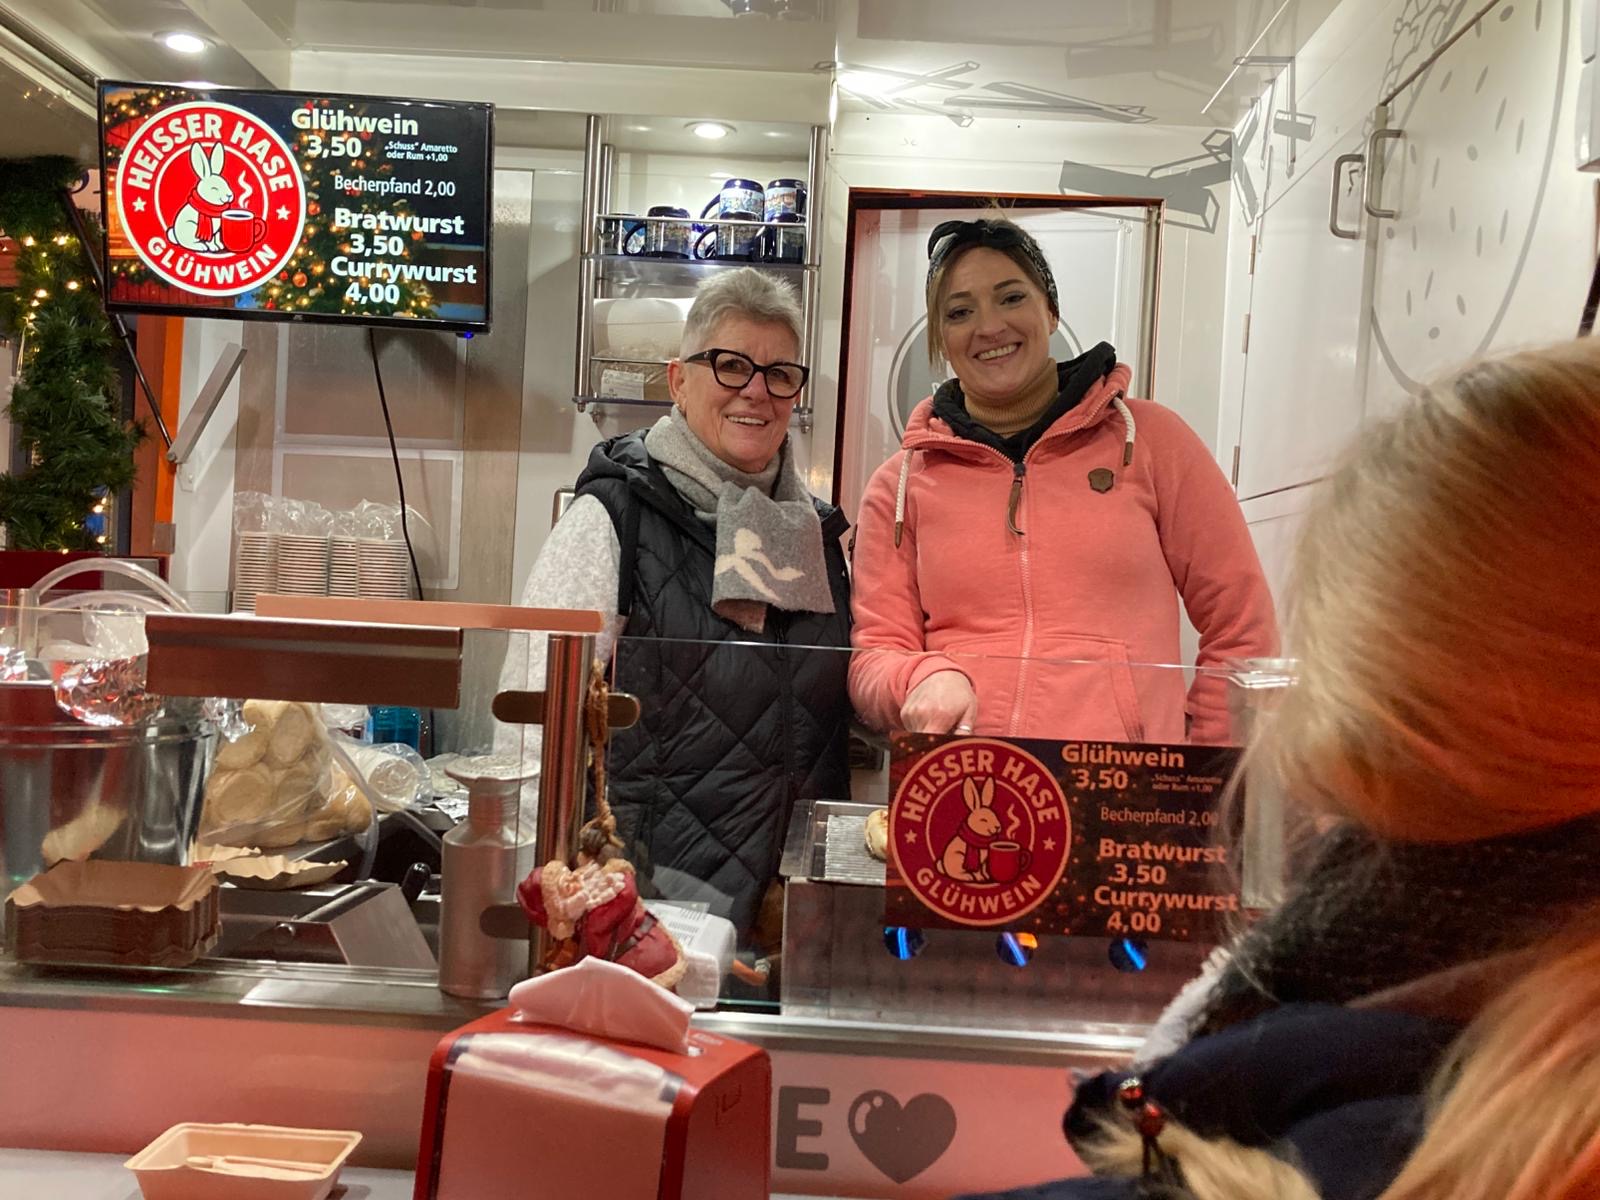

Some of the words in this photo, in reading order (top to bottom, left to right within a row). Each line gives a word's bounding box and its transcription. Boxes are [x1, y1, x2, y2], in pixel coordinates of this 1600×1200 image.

[291, 108, 419, 136] Glühwein
[127, 114, 223, 190] HEISSER
[229, 122, 294, 192] HASE
[307, 135, 362, 159] 3,50
[386, 151, 405, 160] oder
[406, 152, 424, 161] Rum
[425, 152, 448, 163] +1,00
[420, 143, 458, 153] Amaretto
[334, 174, 421, 196] Becherpfand
[424, 179, 456, 198] 2,00
[334, 207, 465, 236] Bratwurst
[349, 235, 404, 257] 3,50
[147, 235, 278, 287] GLÜHWEIN
[330, 256, 477, 285] Currywurst
[345, 282, 400, 306] 4,00
[1060, 744, 1185, 768] Glühwein
[900, 749, 995, 823] HEISSER
[1000, 756, 1060, 823] HASE
[1073, 769, 1129, 790] 3,50
[1101, 806, 1185, 826] Becherpfand
[1100, 837, 1227, 864] Bratwurst
[1115, 864, 1166, 885] 3,50
[916, 867, 1042, 915] GLÜHWEIN
[1094, 886, 1238, 911] Currywurst
[1107, 912, 1161, 933] 4,00
